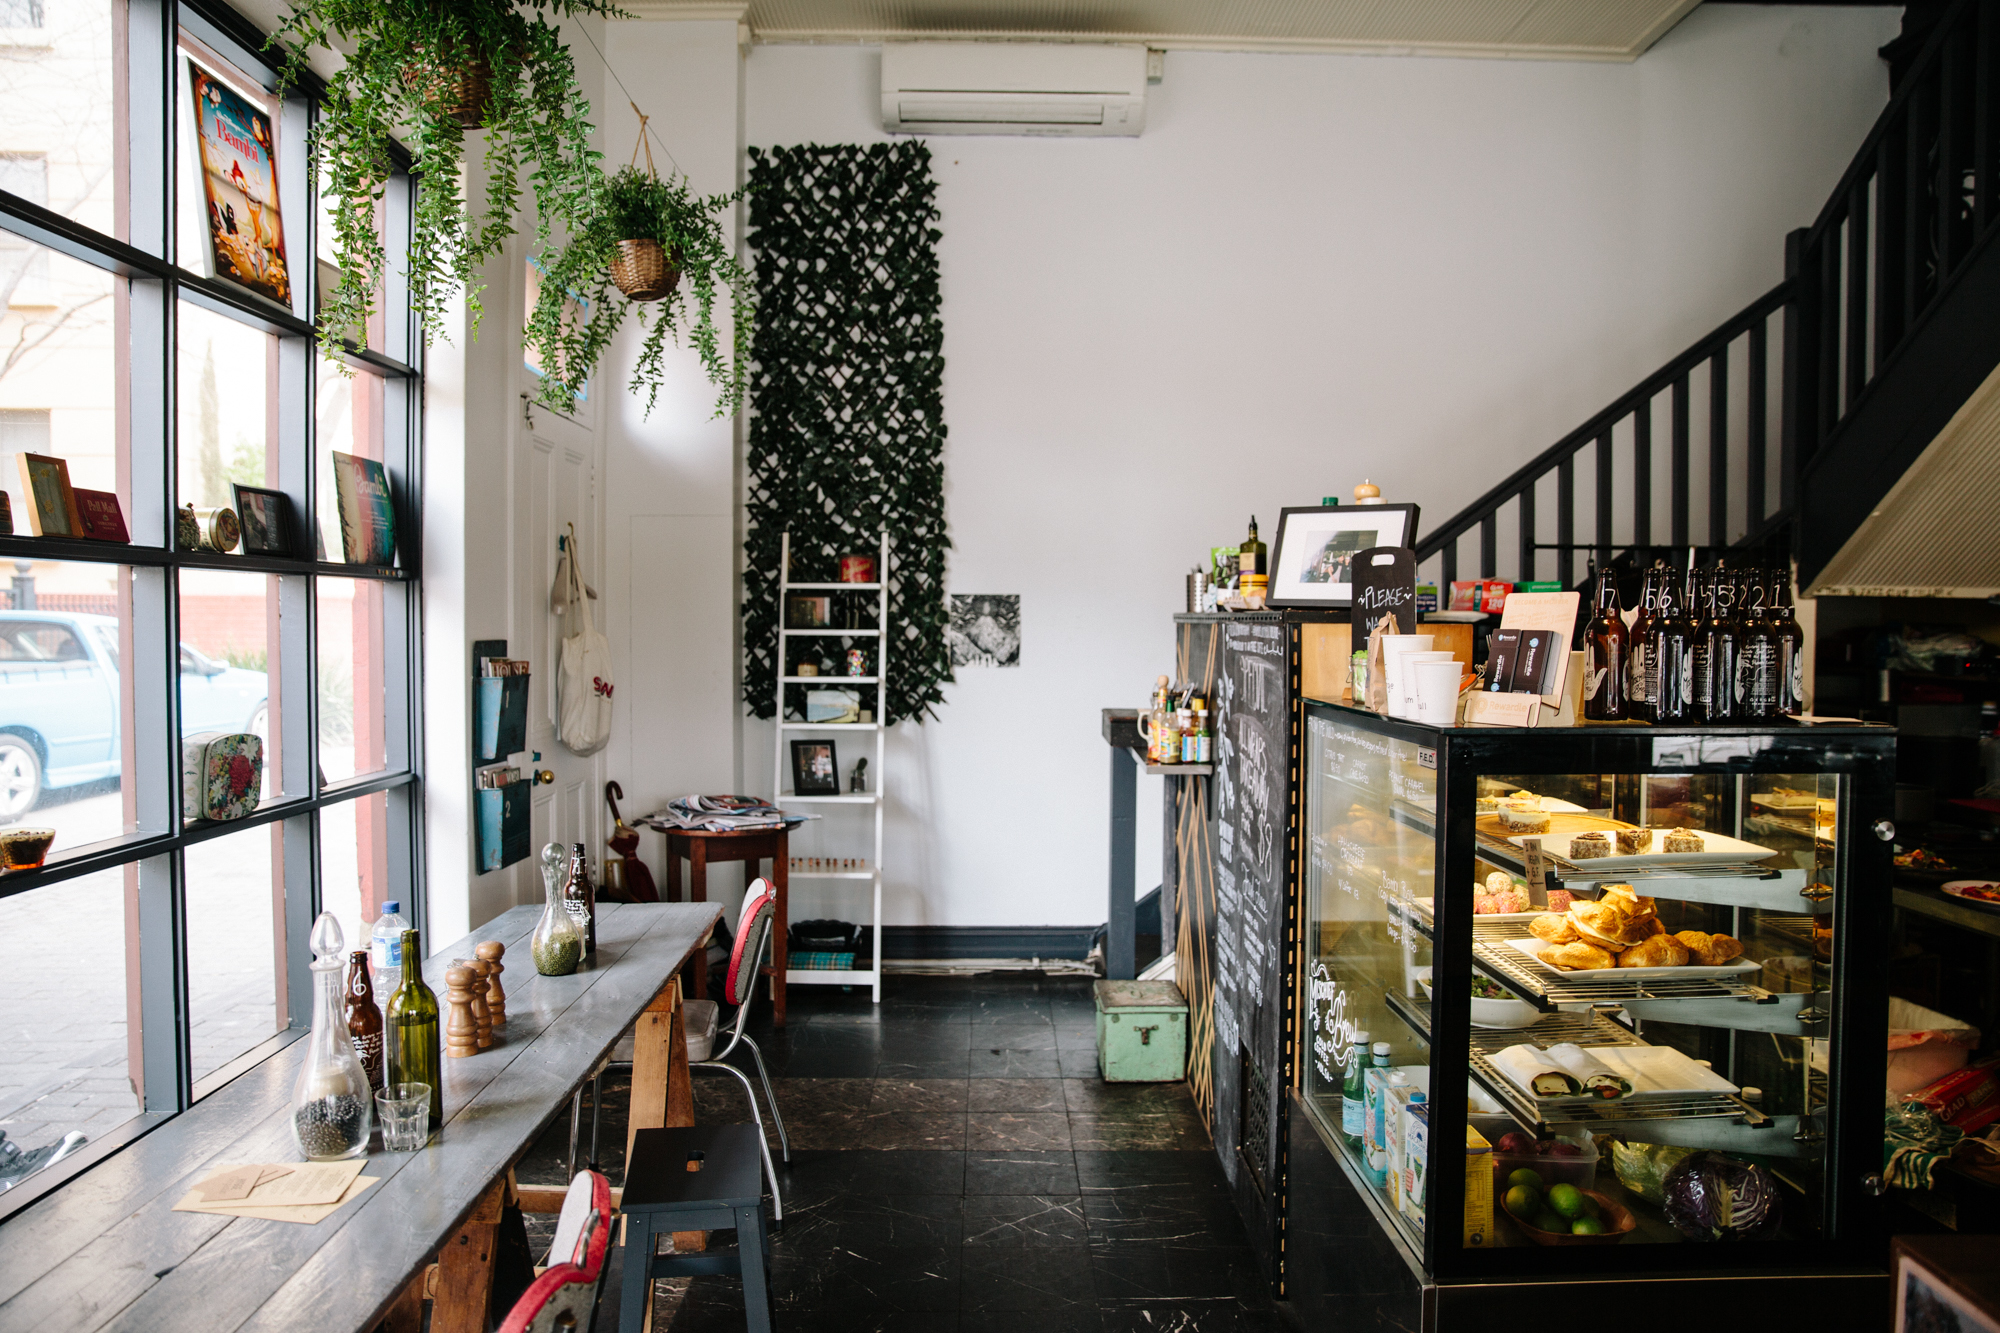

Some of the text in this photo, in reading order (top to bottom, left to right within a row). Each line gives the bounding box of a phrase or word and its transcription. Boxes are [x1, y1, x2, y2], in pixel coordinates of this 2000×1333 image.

[214, 115, 260, 164] Bambi
[354, 463, 387, 497] Bambi
[87, 500, 117, 514] Pall Mall
[1365, 586, 1404, 609] PLEASE
[1605, 588, 1615, 609] 7
[1660, 586, 1672, 609] 6
[1752, 585, 1766, 610] 2
[1770, 584, 1785, 609] 1
[1493, 655, 1503, 683] Rewardle
[1526, 648, 1536, 676] Rewardle
[1489, 700, 1528, 712] Rewardle
[505, 800, 511, 818] 2
[352, 965, 367, 996] 6
[1327, 990, 1357, 1054] Brew
[1939, 1096, 1966, 1122] GLAD
